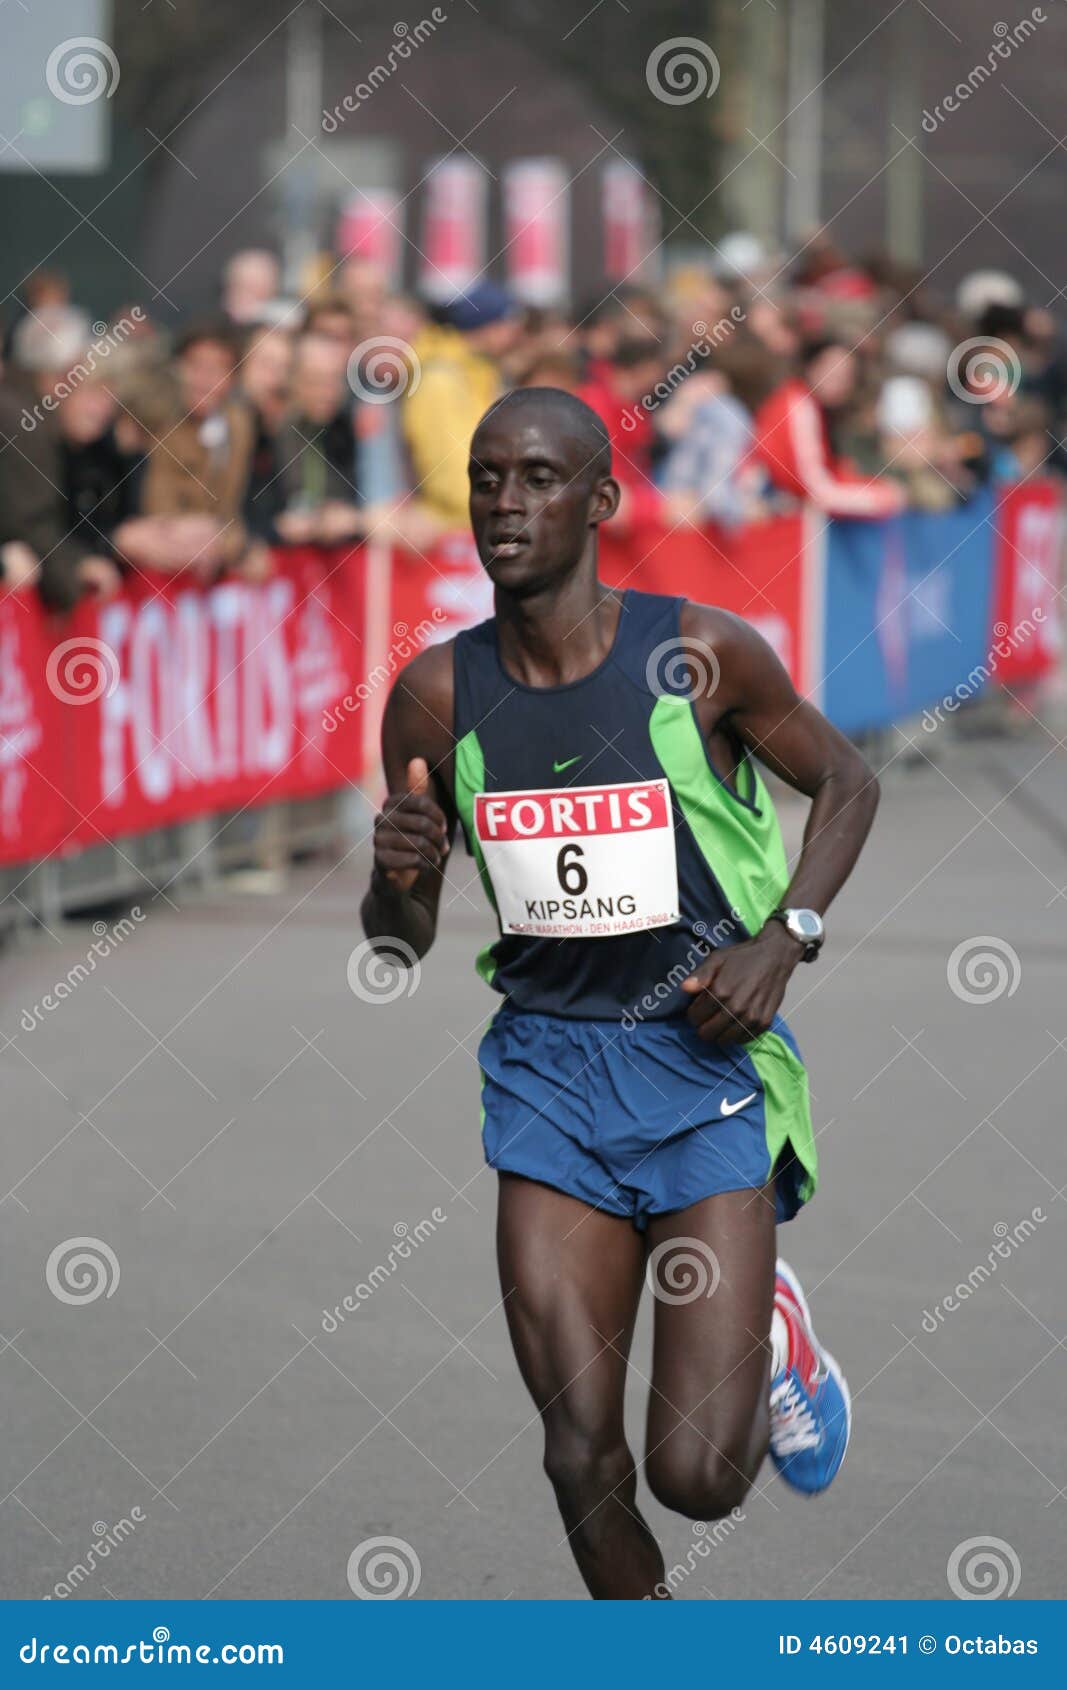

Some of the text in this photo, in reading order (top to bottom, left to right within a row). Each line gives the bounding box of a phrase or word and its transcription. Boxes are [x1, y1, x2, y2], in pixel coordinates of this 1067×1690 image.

[485, 791, 652, 837] FORTIS
[556, 843, 588, 896] 6
[525, 895, 636, 920] KIPSANG
[590, 921, 610, 933] DEN
[614, 918, 643, 931] HAAG
